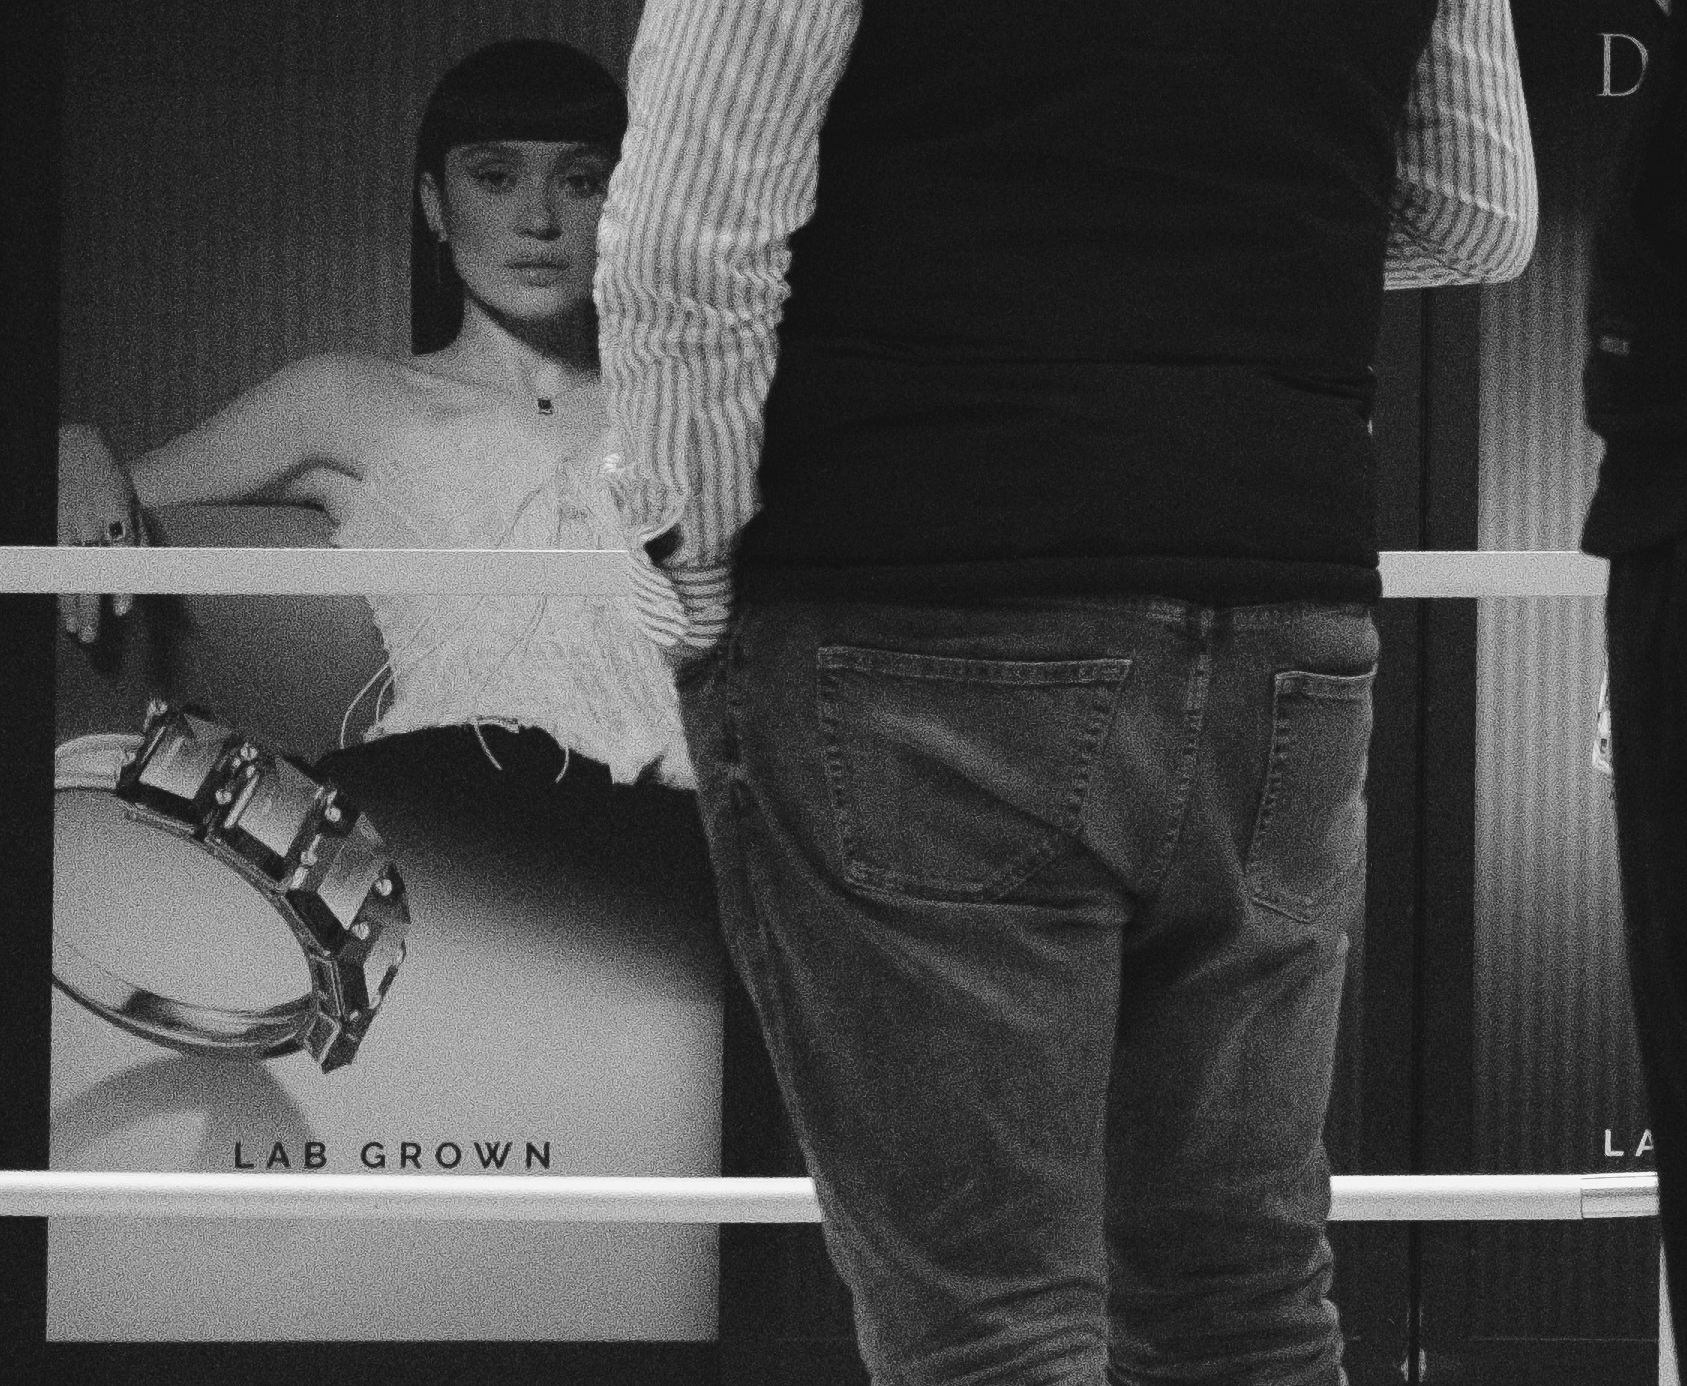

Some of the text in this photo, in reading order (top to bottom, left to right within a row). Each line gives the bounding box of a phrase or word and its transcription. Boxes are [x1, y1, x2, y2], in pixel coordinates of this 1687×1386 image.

[233, 1141, 552, 1170] LAB GROWN
[1604, 1128, 1654, 1157] LA
